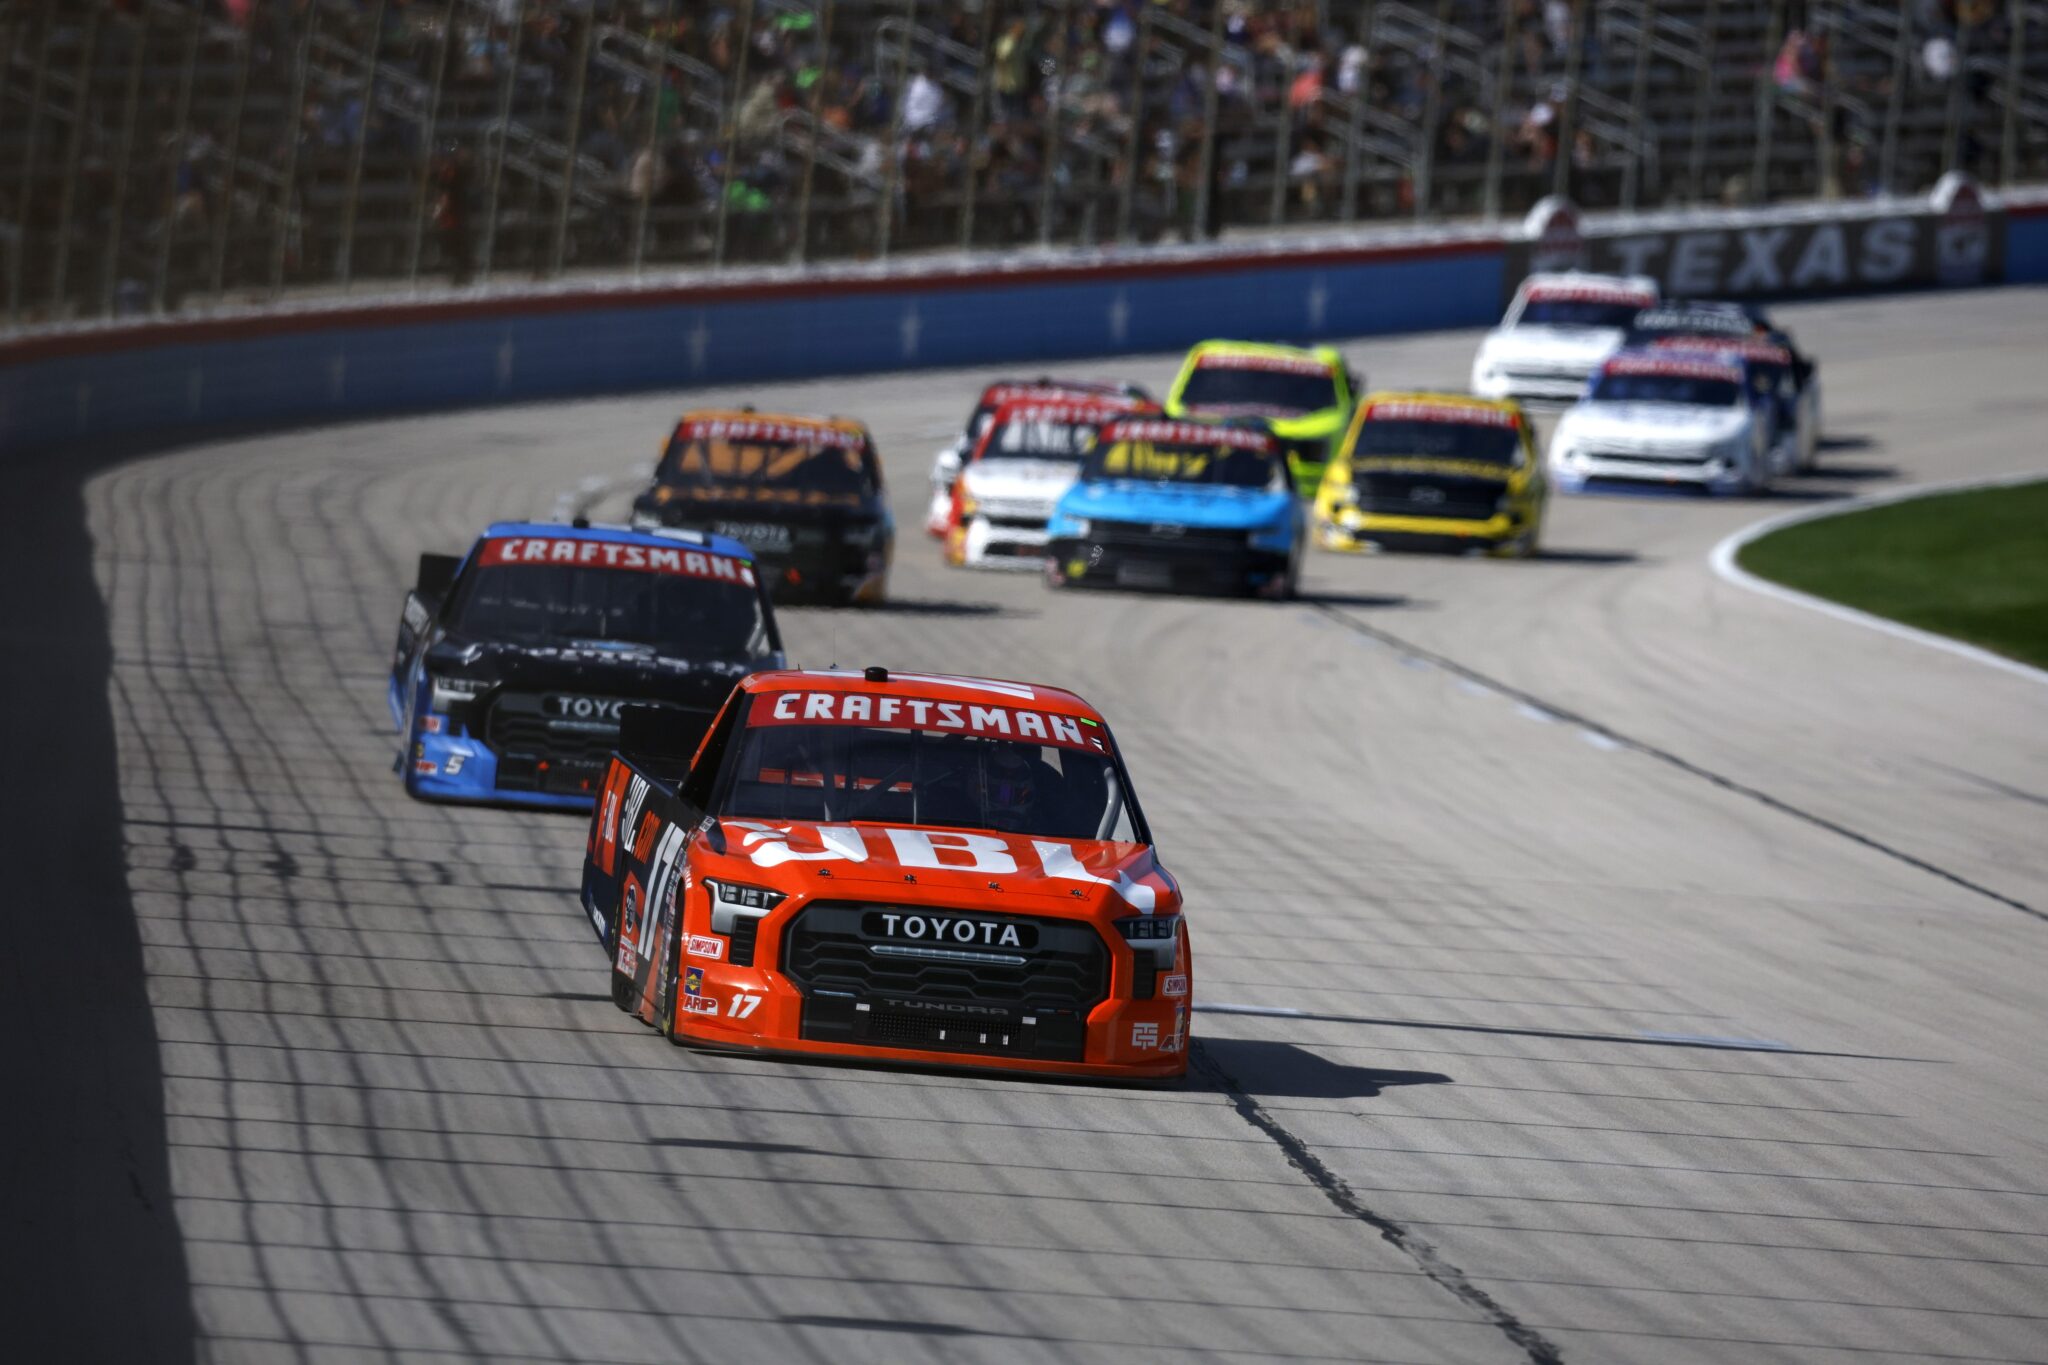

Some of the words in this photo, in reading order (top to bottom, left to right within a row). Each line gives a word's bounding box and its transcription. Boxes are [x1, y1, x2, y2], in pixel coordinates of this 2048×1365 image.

[1607, 218, 1920, 295] TEXAS
[502, 539, 736, 579] CRAFTSMAN
[773, 692, 1085, 746] CRAFTSMAN
[742, 820, 1156, 915] JBL
[689, 939, 718, 955] SIMPSON
[882, 913, 1021, 947] TOYOTA
[683, 995, 717, 1012] ARP
[727, 993, 762, 1019] 17
[884, 999, 1010, 1016] TUNDRA
